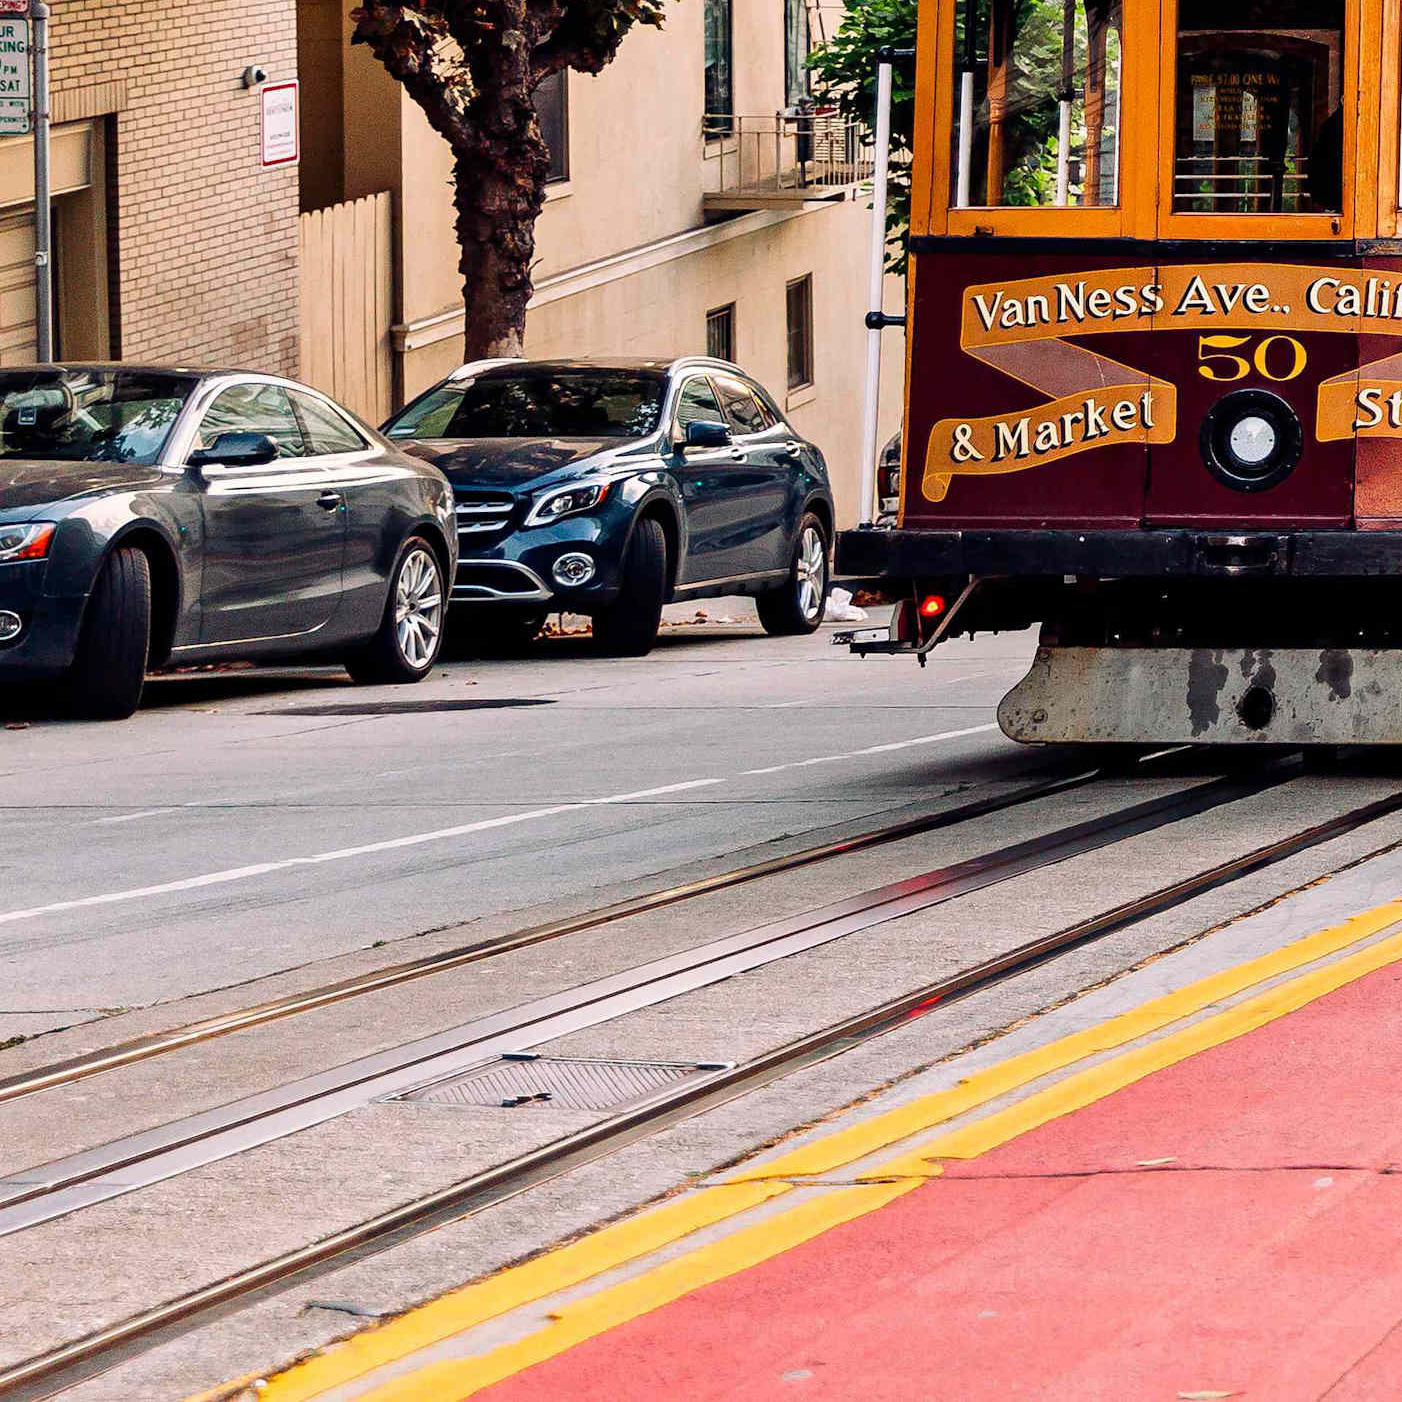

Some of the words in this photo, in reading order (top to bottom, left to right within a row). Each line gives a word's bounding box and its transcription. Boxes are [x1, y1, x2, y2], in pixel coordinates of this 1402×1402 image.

[971, 290, 1050, 332] Van
[1053, 280, 1165, 321] Ness
[1197, 334, 1308, 382] 50
[950, 422, 986, 465] &
[991, 390, 1156, 461] Market
